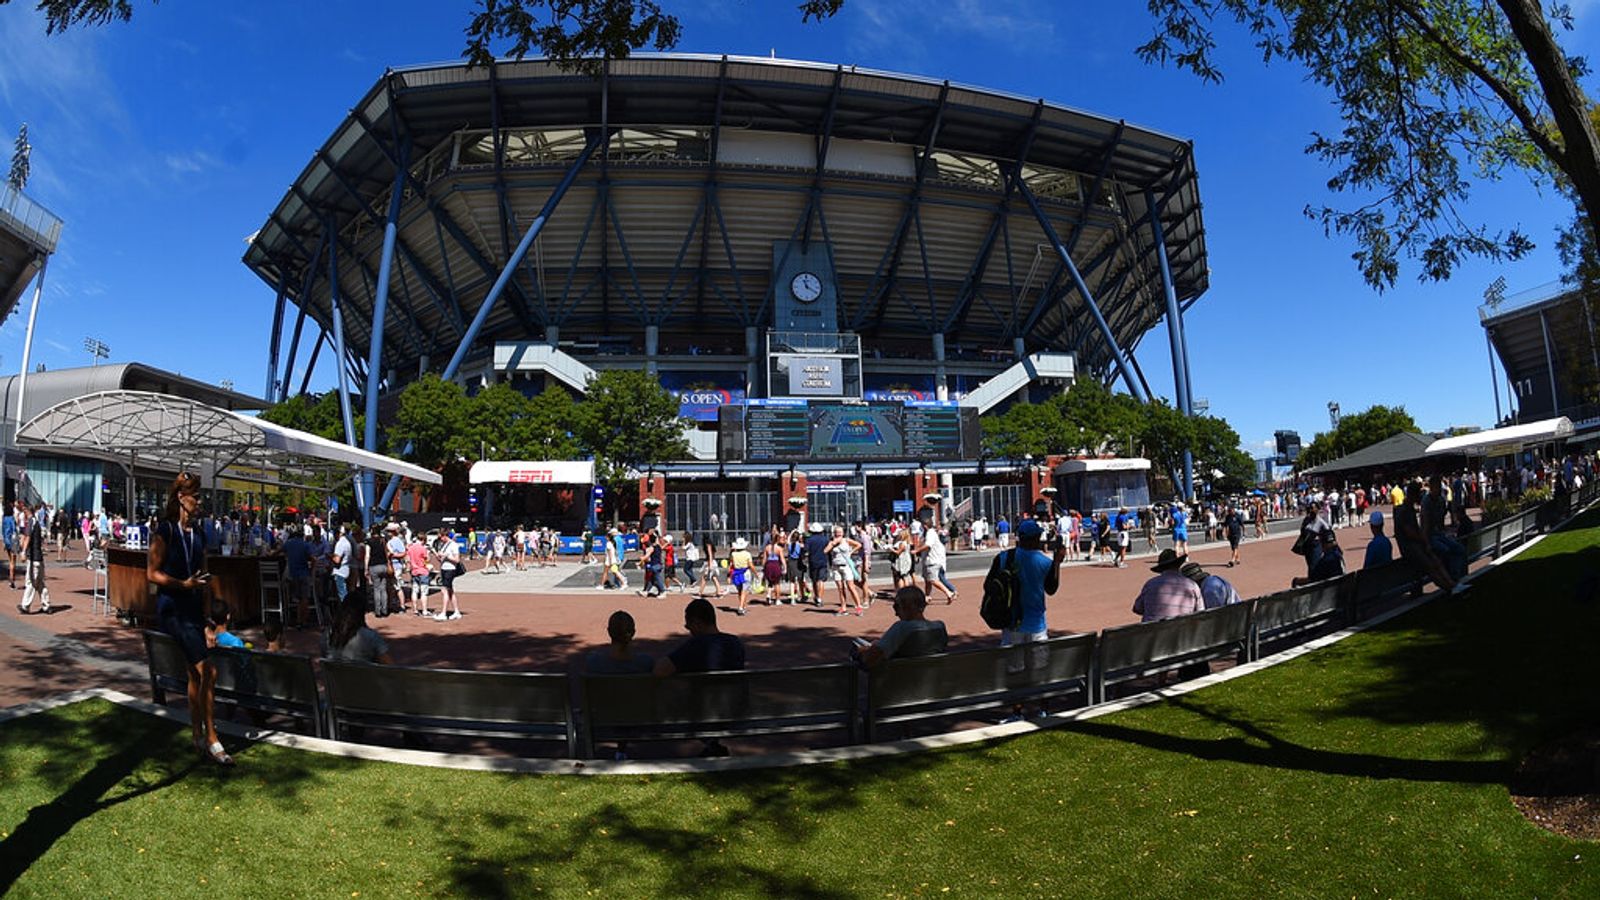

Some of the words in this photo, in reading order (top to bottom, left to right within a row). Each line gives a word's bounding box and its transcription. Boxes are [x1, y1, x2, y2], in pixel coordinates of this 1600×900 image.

[1516, 378, 1533, 397] 11
[690, 393, 723, 404] OPEN
[508, 470, 553, 483] ESPN
